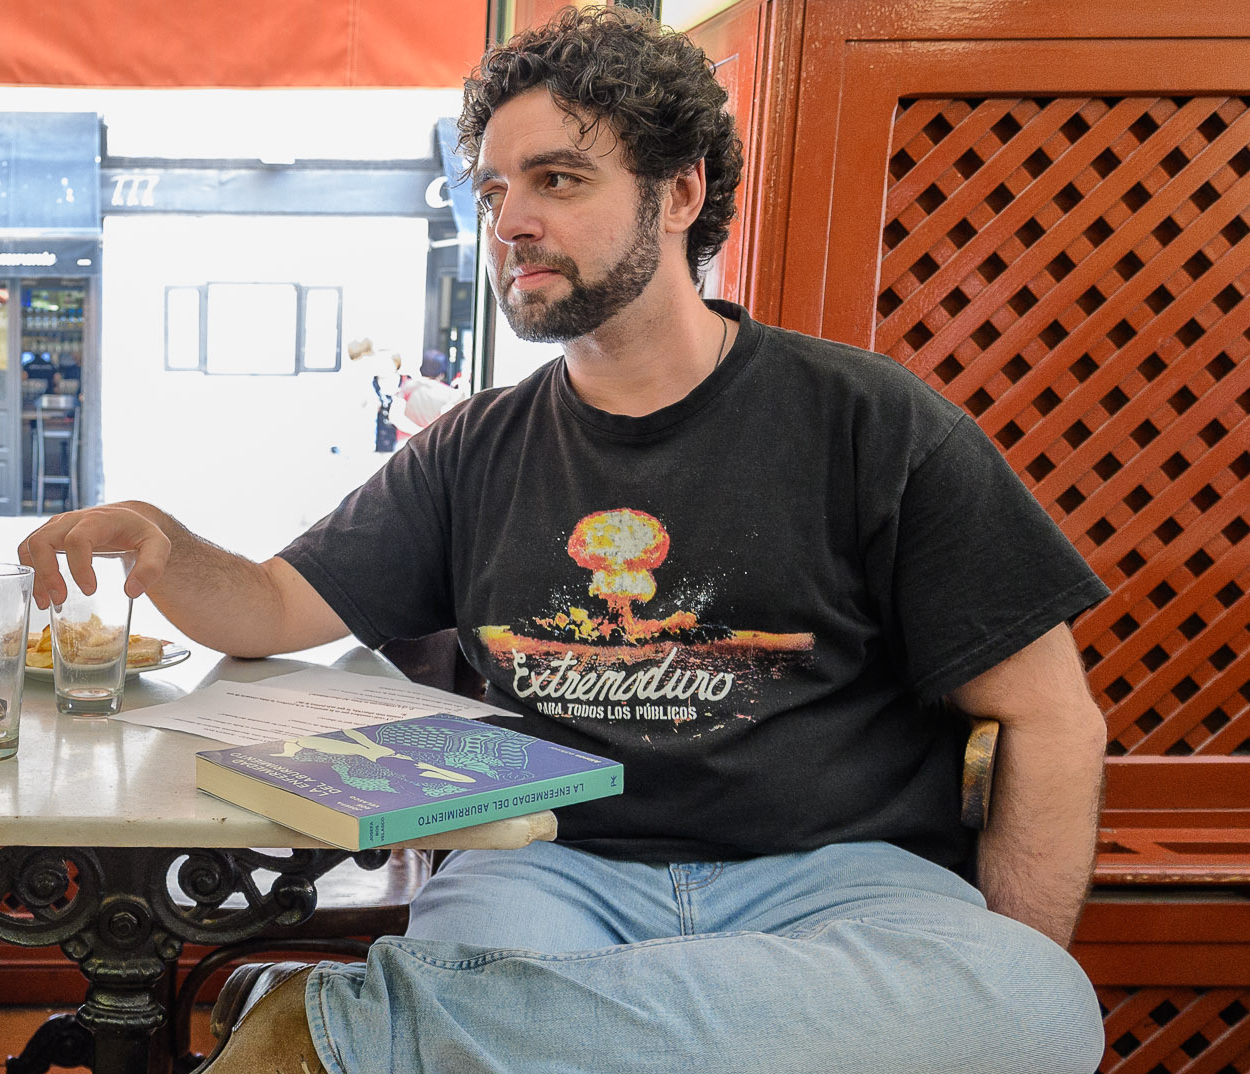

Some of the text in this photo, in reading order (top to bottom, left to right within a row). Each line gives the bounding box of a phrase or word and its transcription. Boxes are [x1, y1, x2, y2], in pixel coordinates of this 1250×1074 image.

[512, 647, 735, 701] Extremoduro
[537, 702, 698, 720] PARA TODOS LOS PÚBLICOS
[230, 752, 342, 795] DEL ABURRIMIENTO
[232, 759, 329, 797] LA ENFERMEDAD
[417, 783, 585, 827] LA ENFERMEDAD DEL ABURRIMIENTO
